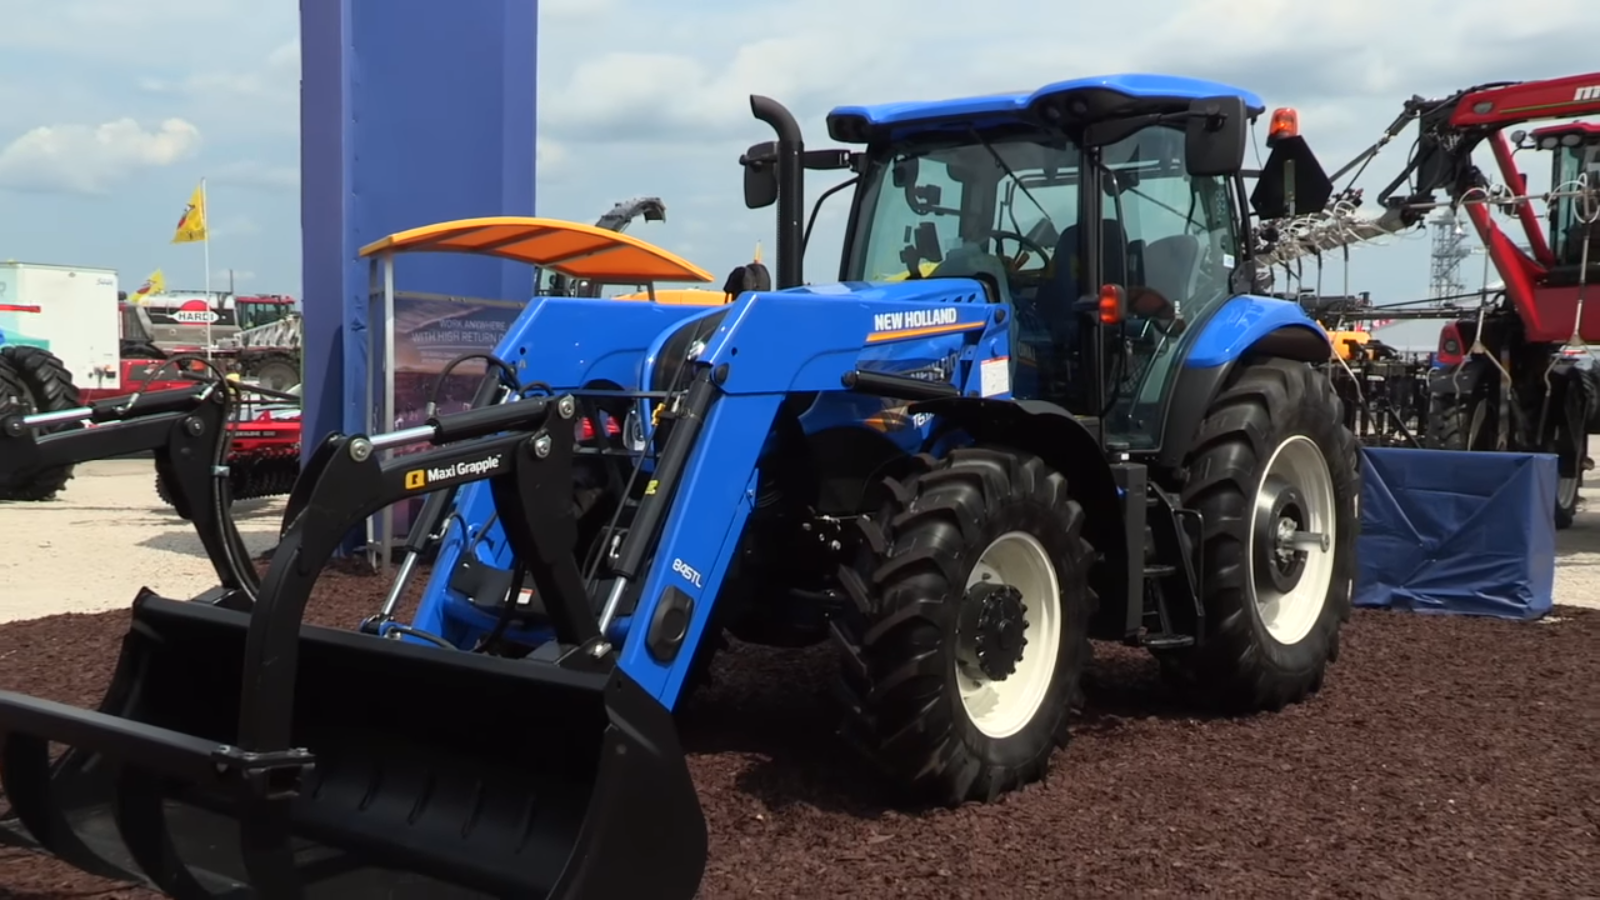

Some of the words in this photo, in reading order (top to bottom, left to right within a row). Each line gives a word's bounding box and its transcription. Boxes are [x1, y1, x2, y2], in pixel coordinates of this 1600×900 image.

[178, 312, 215, 321] HARDI
[439, 319, 463, 329] WORK
[874, 311, 904, 331] NEW
[905, 307, 957, 328] HOLLAND
[412, 331, 437, 343] WITH
[438, 331, 460, 342] HIGH
[461, 331, 497, 343] RETURN
[427, 464, 456, 483] Maxi
[671, 557, 702, 588] 845TL
